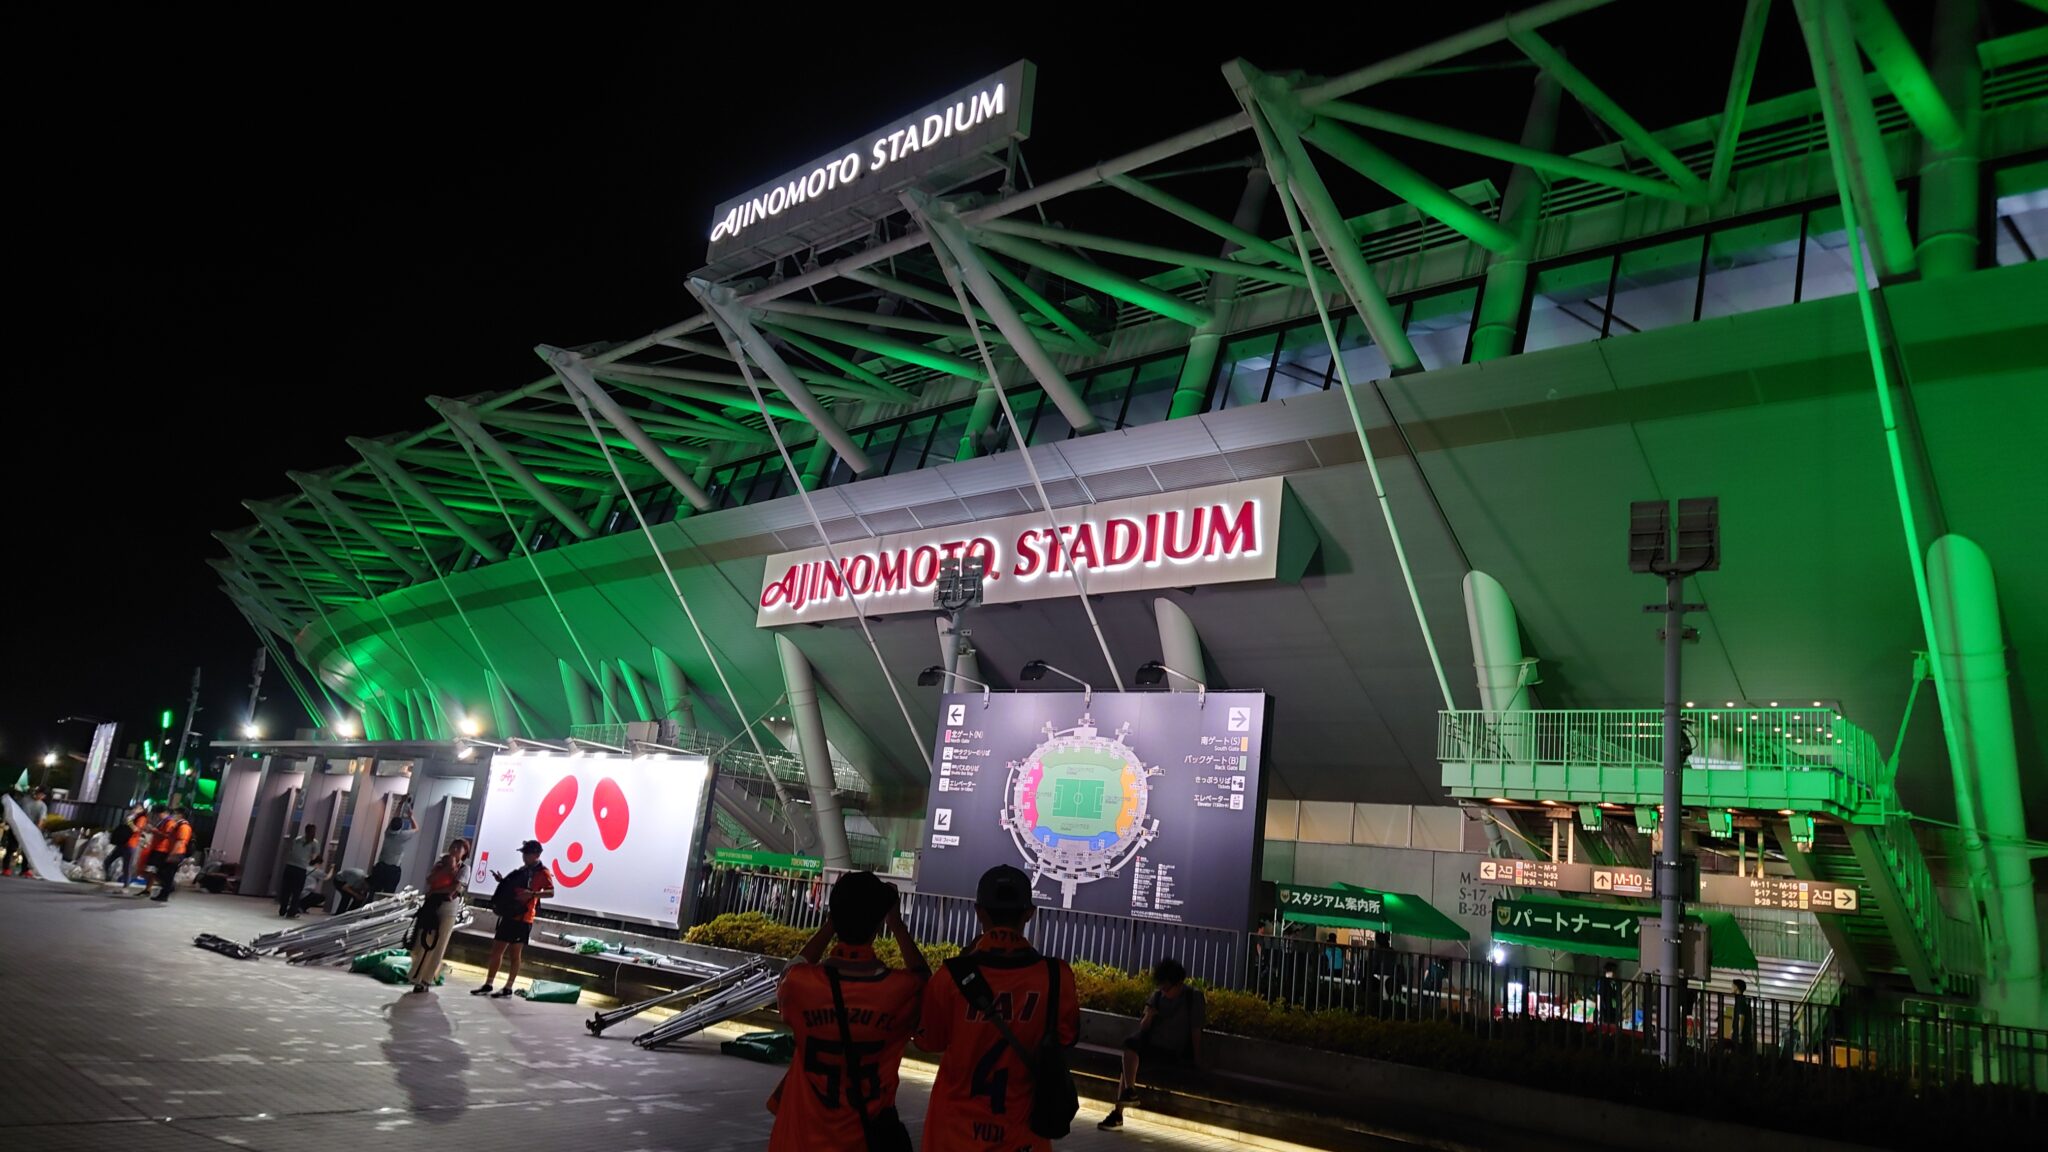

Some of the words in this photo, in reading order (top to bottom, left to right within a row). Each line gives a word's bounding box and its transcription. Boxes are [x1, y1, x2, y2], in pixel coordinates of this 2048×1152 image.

[710, 152, 861, 243] AJINOMOTO
[870, 82, 1005, 172] STADIUM
[1013, 500, 1257, 577] STADIUM
[1200, 736, 1241, 746] 南ゲート(S)
[1184, 754, 1239, 765] バックゲート(B)
[1195, 776, 1231, 784] きっぷうりば
[1194, 794, 1230, 802] エレベーター
[1498, 865, 1513, 875] 入口
[1524, 862, 1536, 871] M-1
[1613, 873, 1643, 887] M-10
[1750, 880, 1770, 889] M-11
[1779, 881, 1798, 890] M-16
[1754, 889, 1770, 897] S-17
[1781, 890, 1798, 899] S-27
[1812, 889, 1832, 900] 入口
[1291, 891, 1381, 914] スタジアム案内所
[1754, 897, 1771, 906] B-28
[1781, 899, 1798, 908] B-35
[803, 1008, 874, 1027] SHIZU
[970, 1038, 1009, 1114] 4
